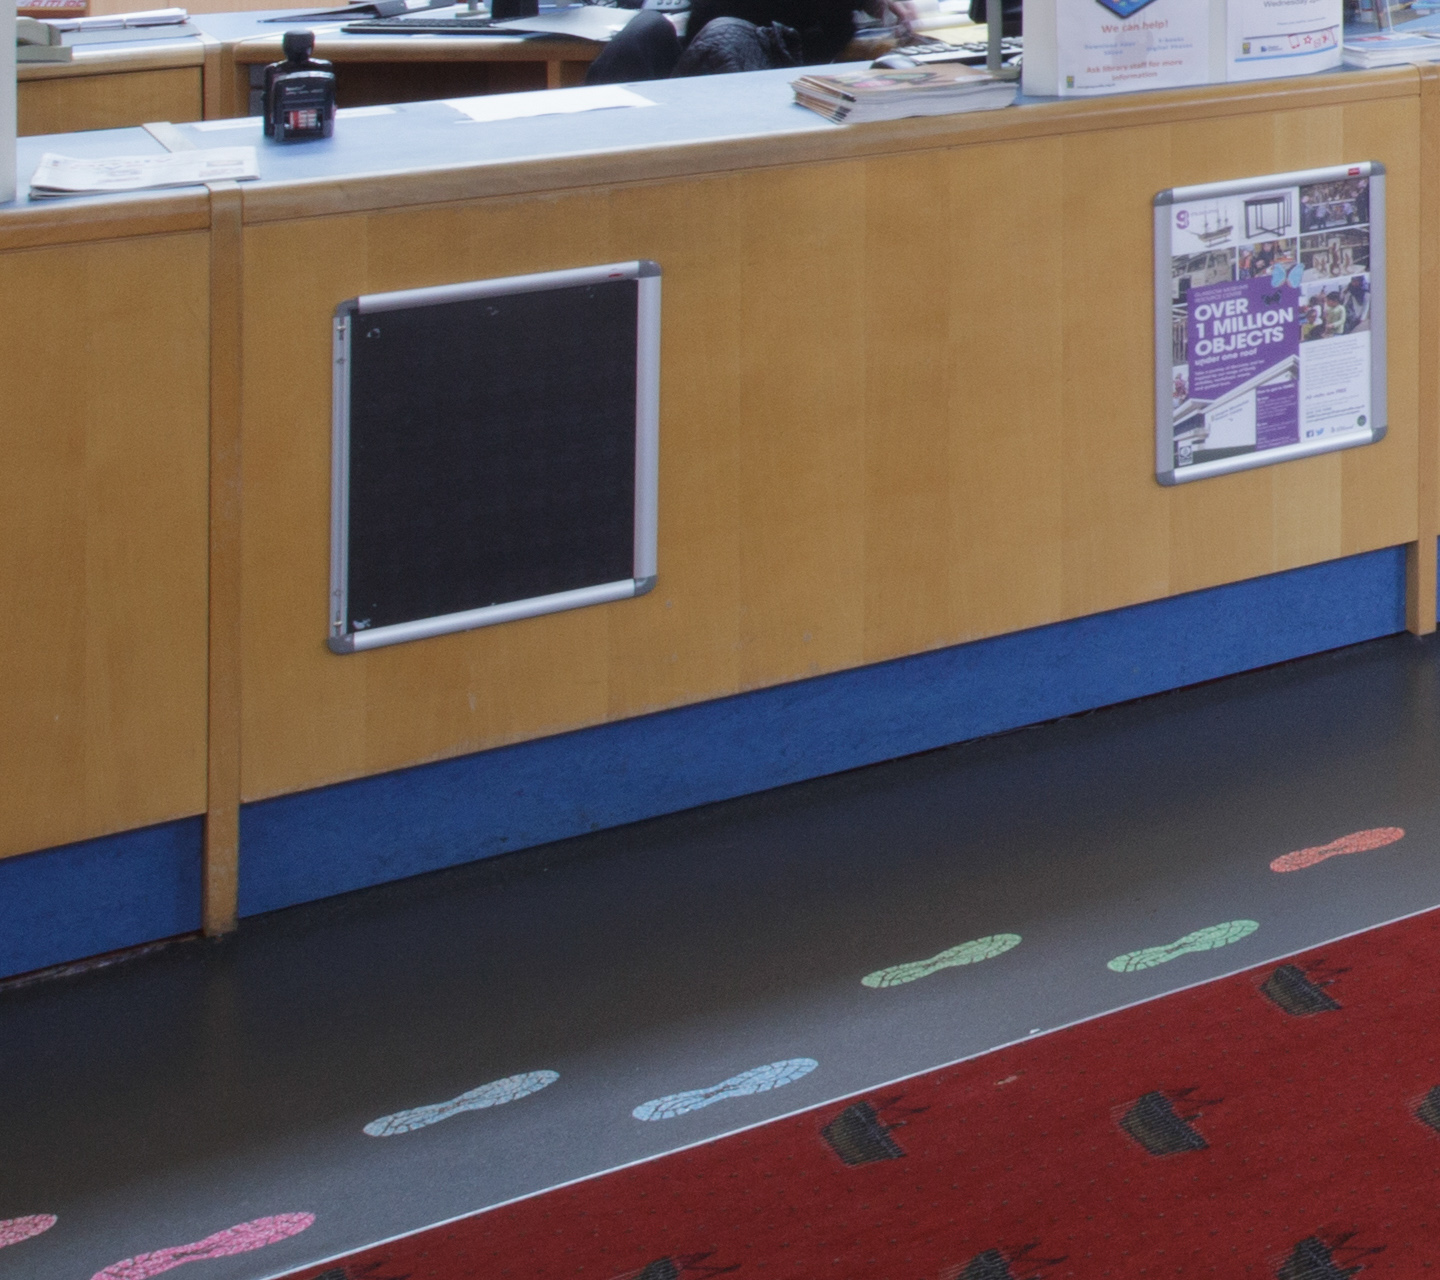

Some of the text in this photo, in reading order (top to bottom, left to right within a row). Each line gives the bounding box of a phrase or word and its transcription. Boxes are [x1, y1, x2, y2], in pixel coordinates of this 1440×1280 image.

[1101, 19, 1169, 34] We can help!
[1103, 63, 1128, 73] library
[1130, 61, 1148, 70] staff
[1112, 70, 1158, 81] information
[1194, 297, 1249, 321] OVER
[1196, 307, 1294, 339] 1 MILLION
[1195, 326, 1284, 357] OBJECTS
[1195, 348, 1257, 366] under one roof
